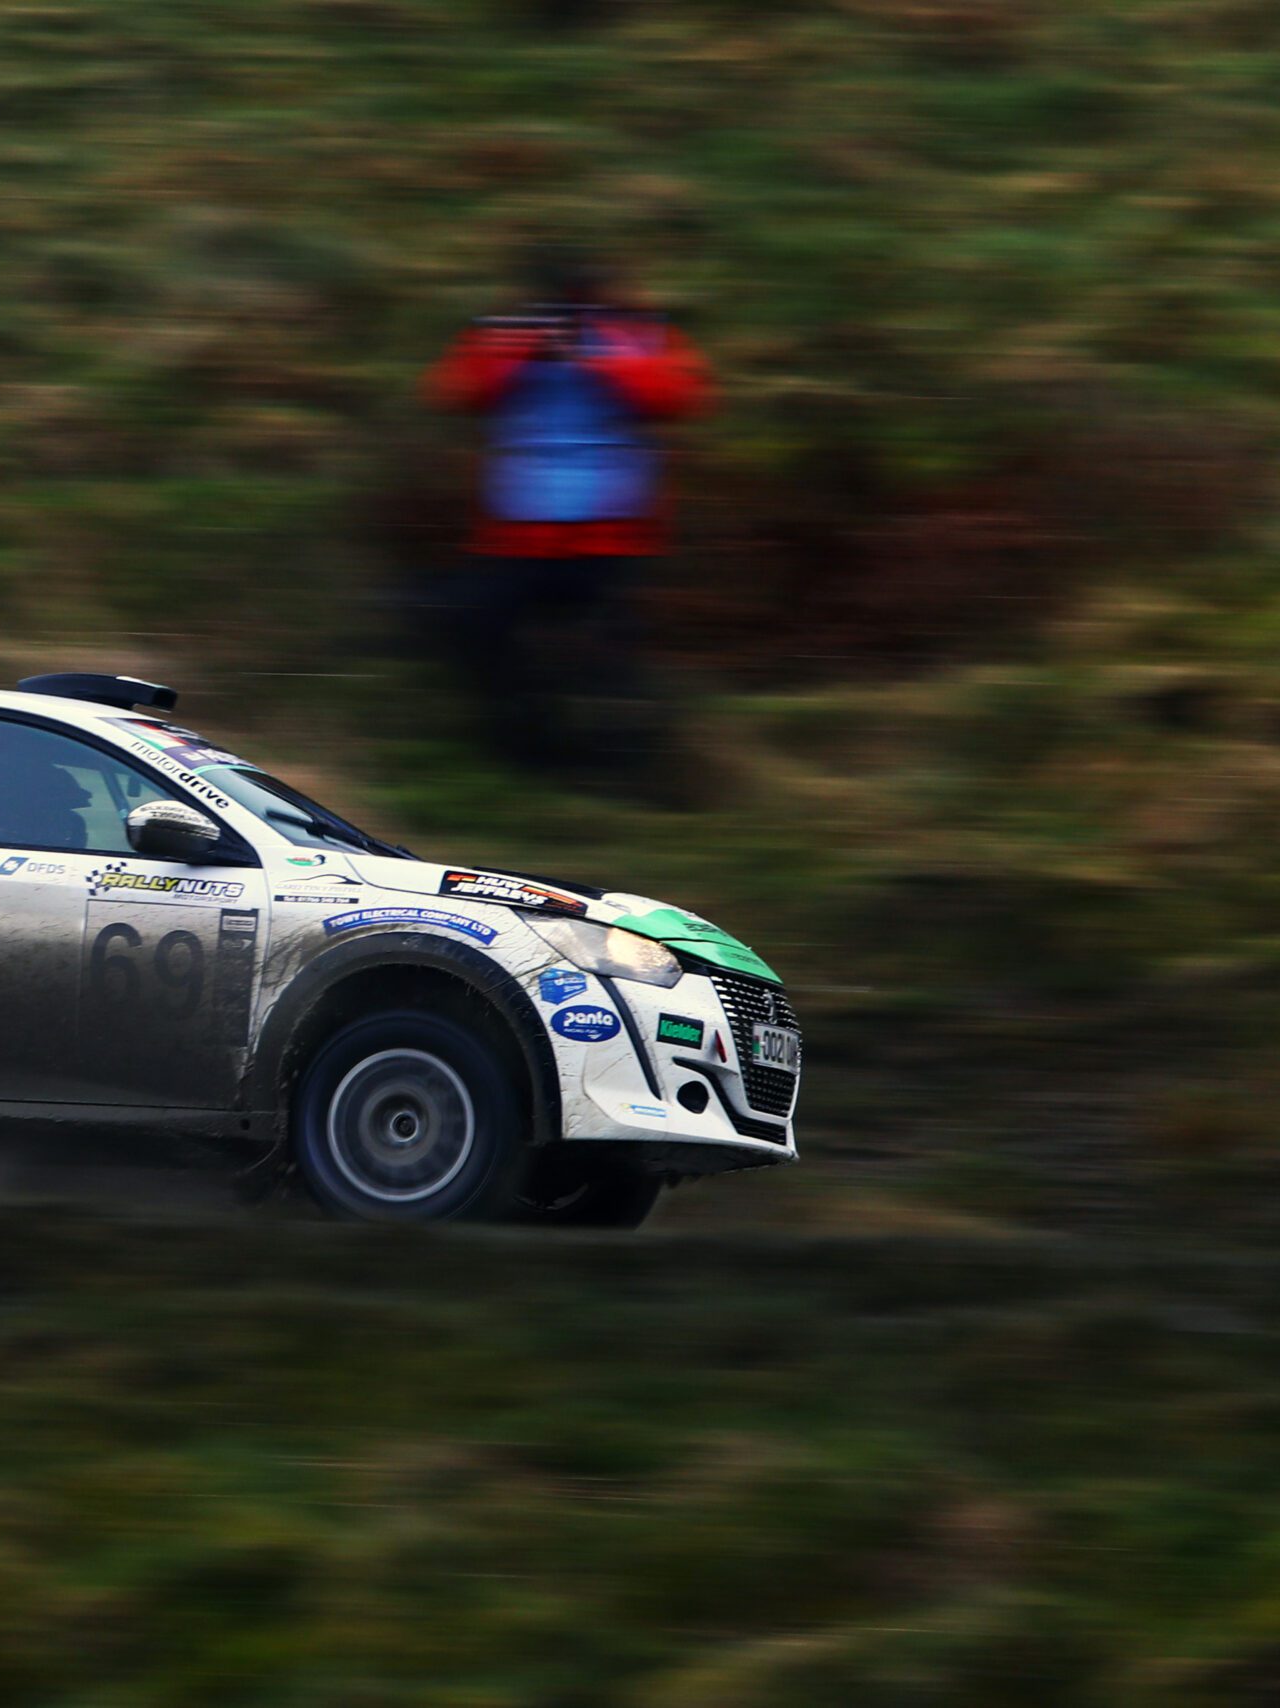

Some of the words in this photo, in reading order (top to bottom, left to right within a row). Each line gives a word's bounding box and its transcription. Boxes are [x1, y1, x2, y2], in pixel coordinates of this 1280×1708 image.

[130, 741, 229, 808] motordrive
[27, 862, 66, 875] DFDS
[450, 882, 549, 906] JEFFREYS
[475, 876, 524, 890] HUW
[329, 912, 361, 927] TOWY
[362, 909, 419, 920] ELECTRICAL
[420, 911, 469, 927] COMPANY
[471, 922, 492, 936] LTD
[91, 922, 206, 1018] 69
[563, 1011, 614, 1027] panta
